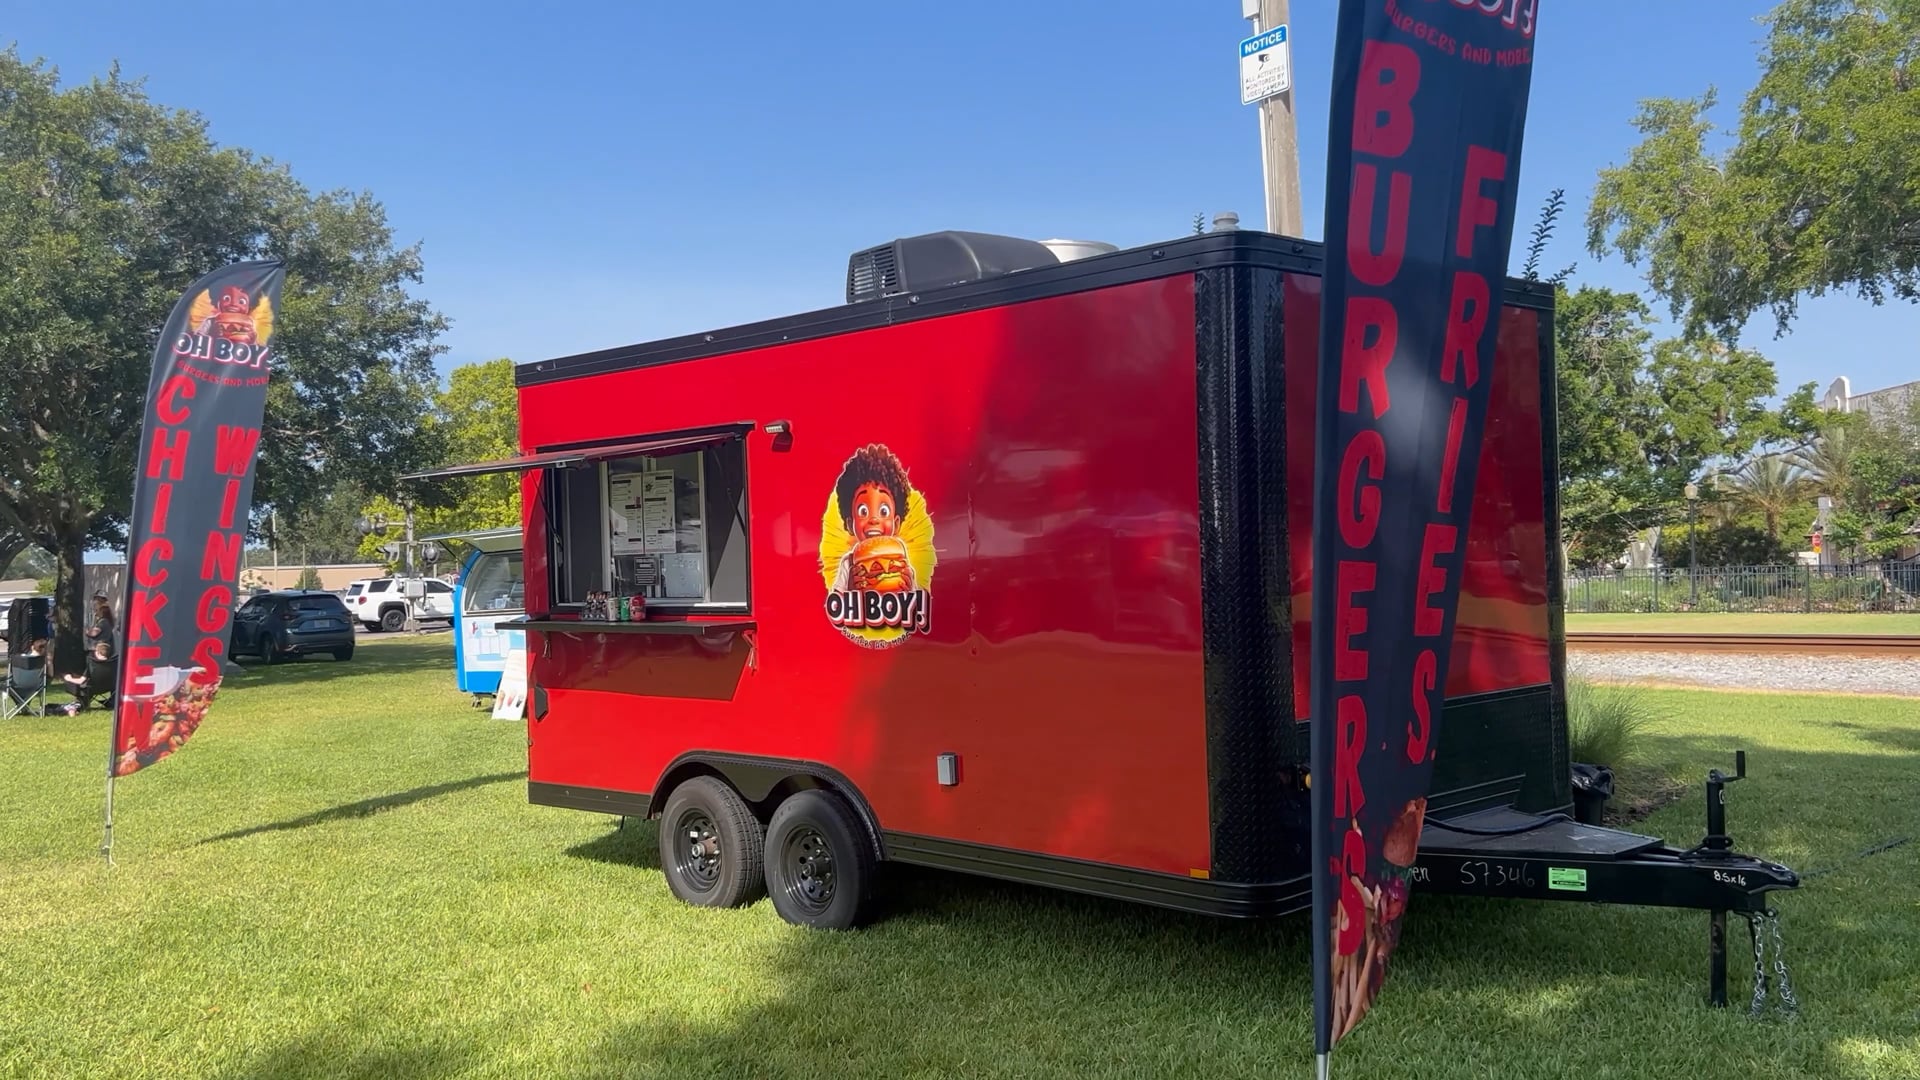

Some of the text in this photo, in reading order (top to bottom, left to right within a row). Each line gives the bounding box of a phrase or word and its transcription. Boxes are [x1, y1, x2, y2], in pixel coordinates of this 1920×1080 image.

[1244, 30, 1283, 54] NOTICE
[1384, 0, 1532, 68] BURGERS AND MORE
[174, 332, 212, 359] OH
[176, 360, 220, 385] BURGERS
[223, 376, 243, 388] AND
[1407, 145, 1507, 764] FRIES
[1334, 39, 1421, 956] BURGERS
[118, 374, 197, 753] CHICKEN
[188, 425, 260, 685] WINGS
[825, 589, 930, 627] OH BOY!
[1713, 869, 1747, 887] 8.5x16
